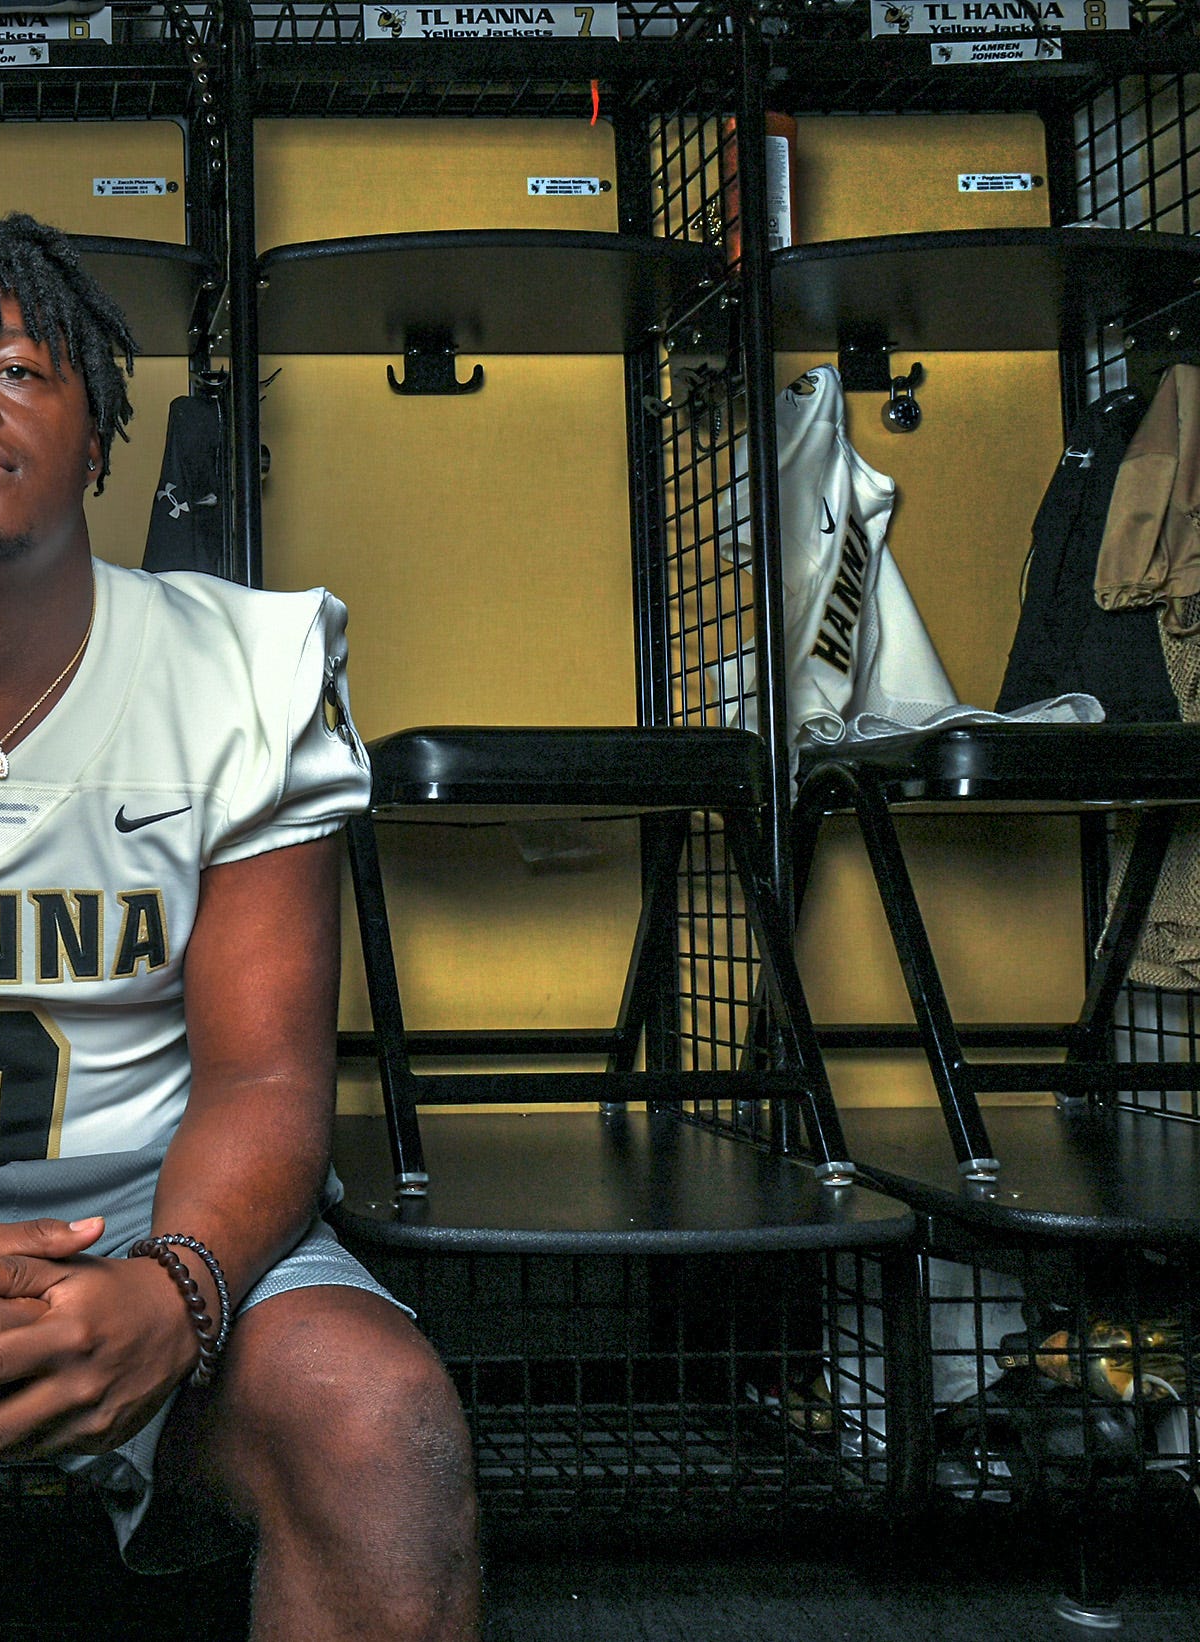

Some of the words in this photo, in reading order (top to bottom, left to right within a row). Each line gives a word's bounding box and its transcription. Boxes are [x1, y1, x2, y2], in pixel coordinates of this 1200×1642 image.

[416, 9, 450, 25] TL
[455, 8, 556, 25] HANNA
[573, 6, 595, 37] 7
[923, 3, 957, 21] TL
[962, 2, 1065, 20] HANNA
[1083, 0, 1106, 31] 8
[68, 13, 91, 40] 6
[421, 29, 481, 39] Yellow
[482, 28, 554, 38] Jackets
[928, 24, 991, 35] Yellow
[970, 51, 1024, 61] JOHNSON
[971, 43, 1021, 52] KAMREN
[808, 514, 869, 676] HANNA
